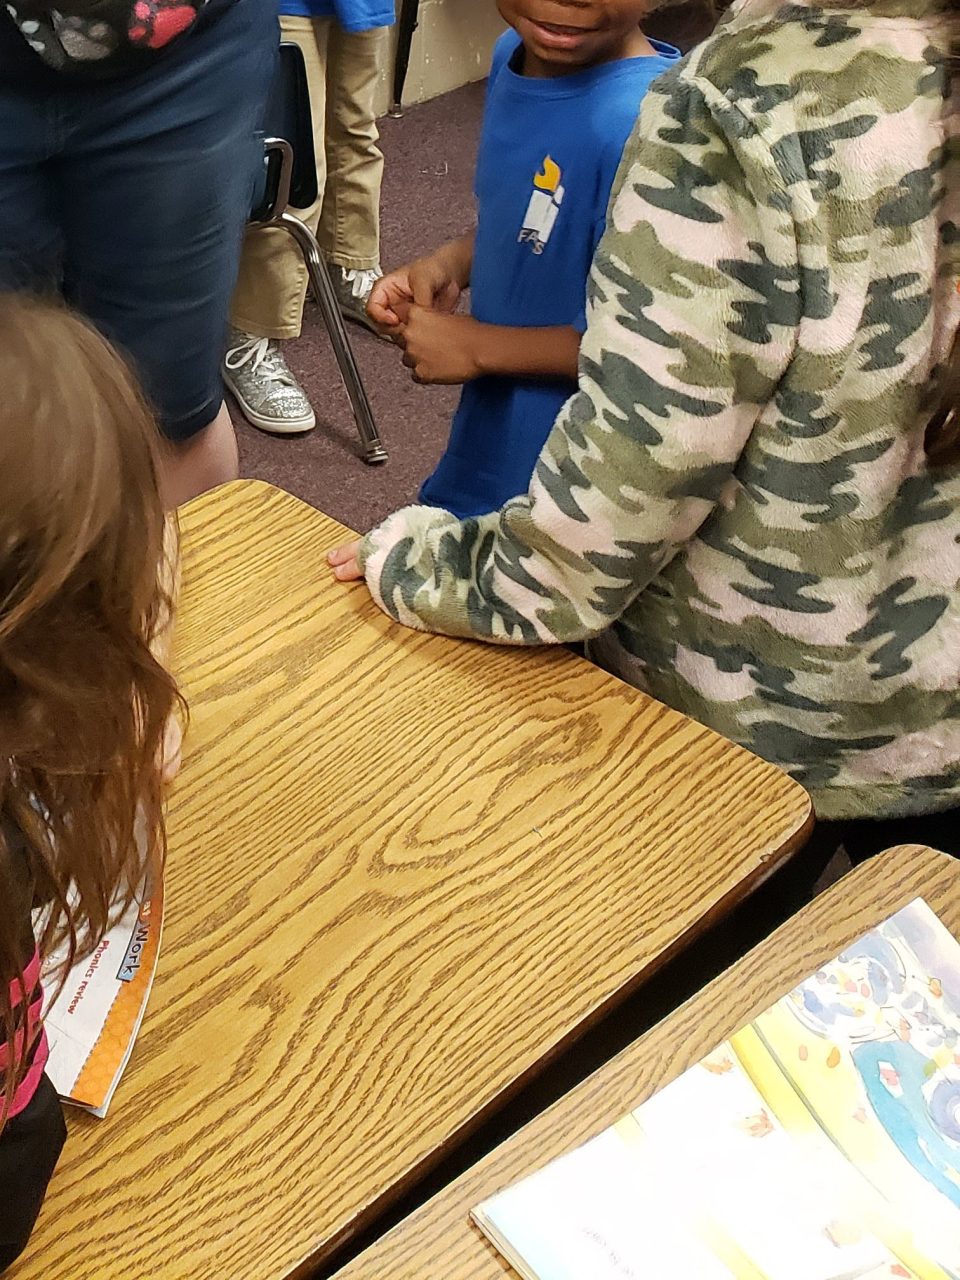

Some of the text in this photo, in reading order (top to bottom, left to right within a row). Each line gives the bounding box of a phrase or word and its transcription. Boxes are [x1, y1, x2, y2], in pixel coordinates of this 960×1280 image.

[67, 940, 110, 1014] Phonics review
[123, 923, 151, 975] Work
